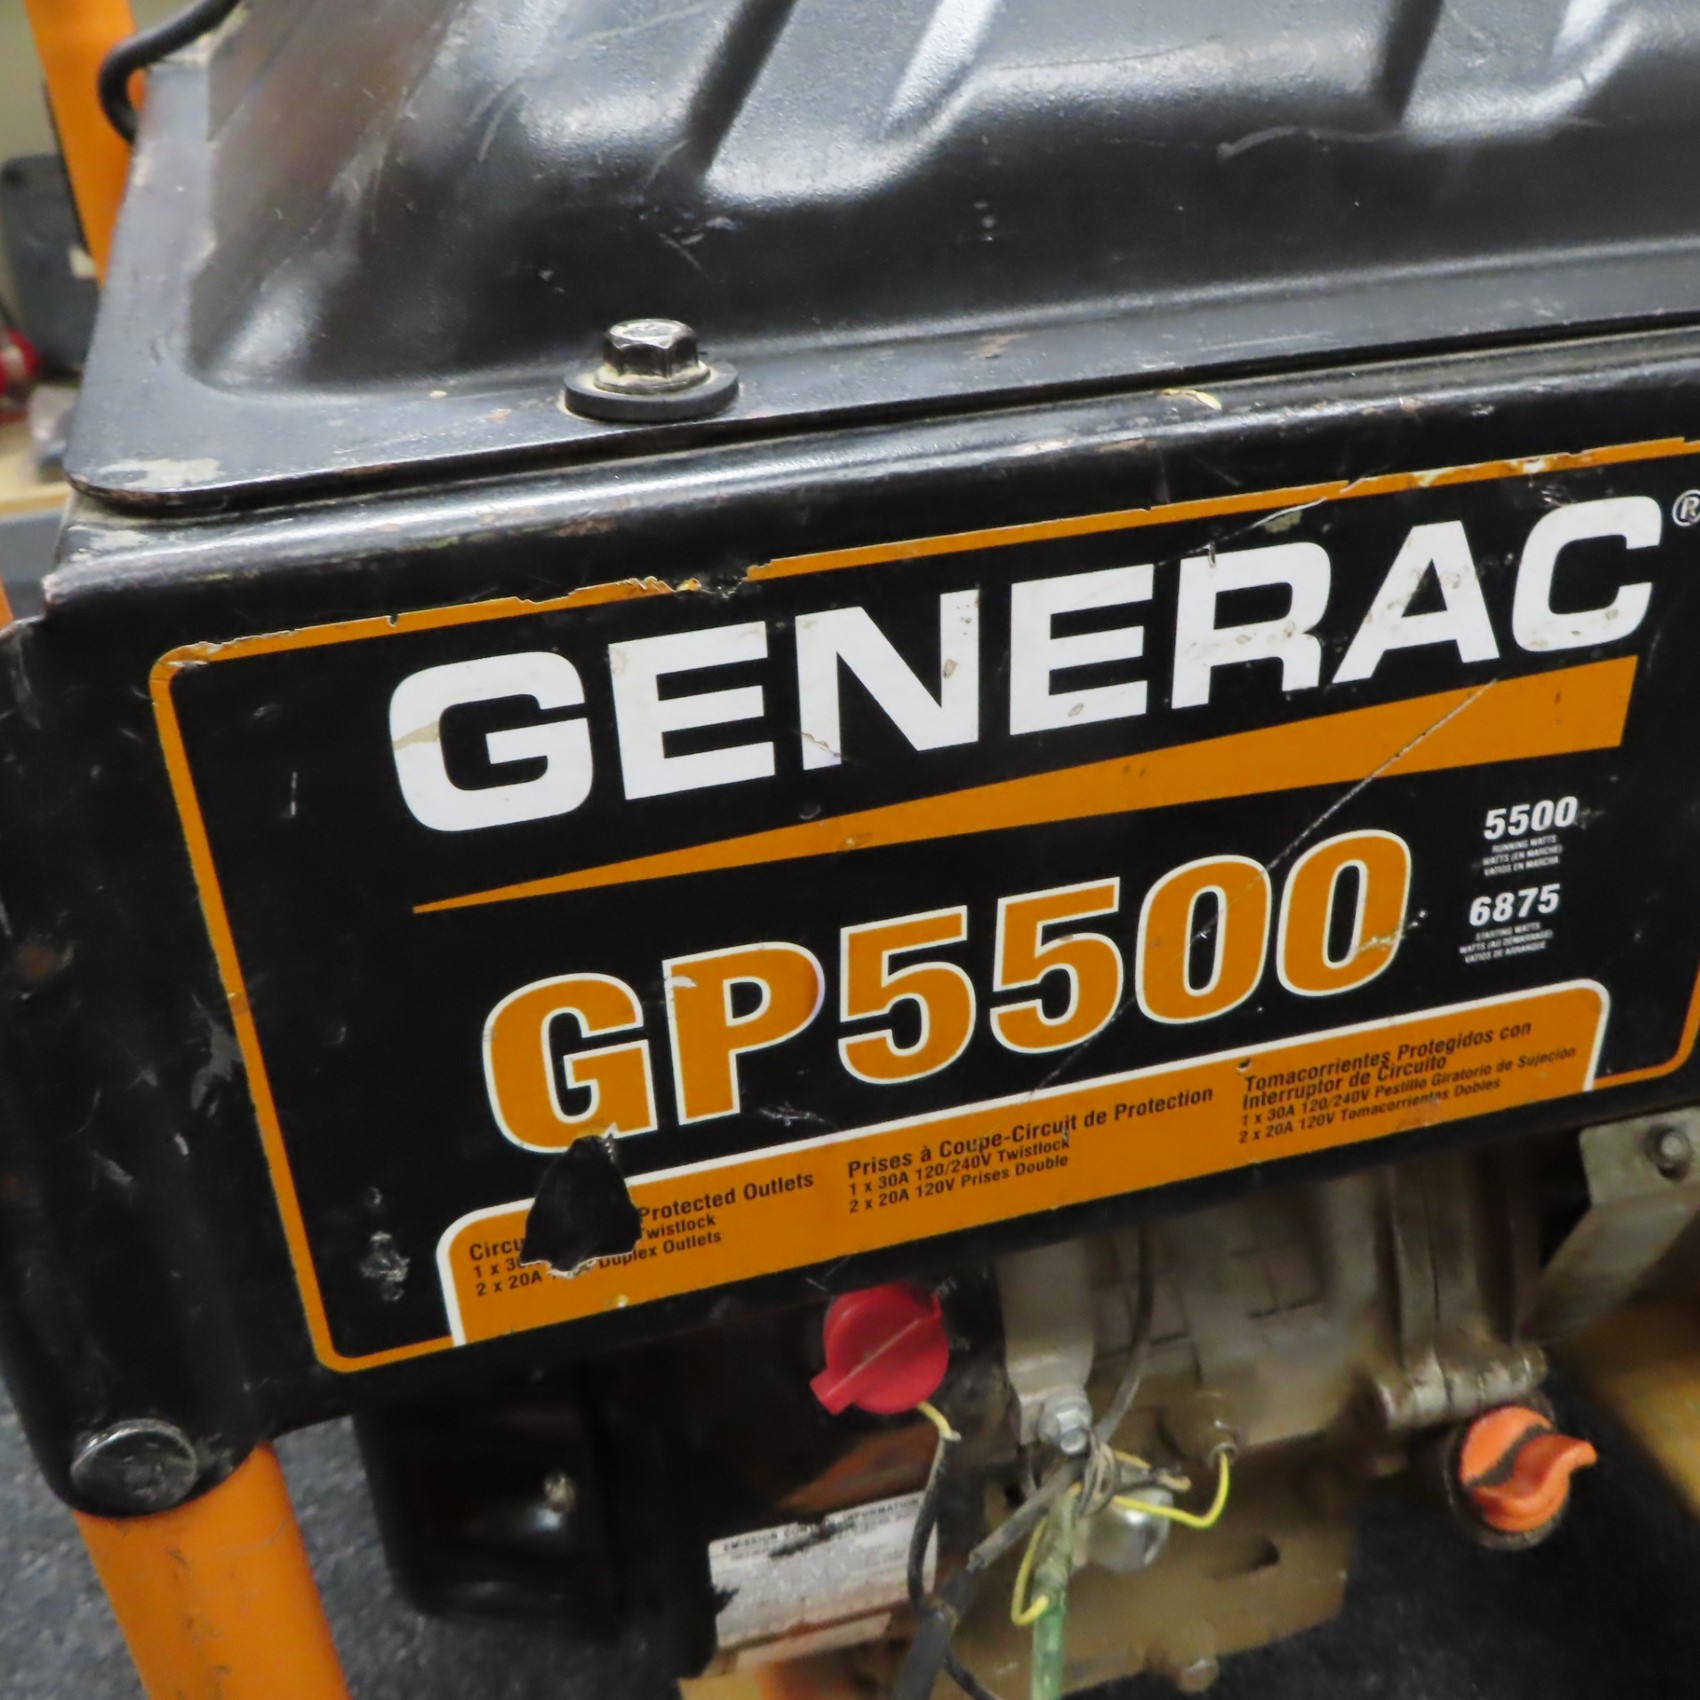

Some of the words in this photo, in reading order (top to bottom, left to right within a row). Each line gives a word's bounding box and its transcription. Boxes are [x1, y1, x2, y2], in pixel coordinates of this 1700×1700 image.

[389, 496, 1661, 832] GENERAC
[1483, 796, 1578, 840] 5500
[1469, 883, 1561, 926] 6875
[483, 829, 1412, 1153] GP5500
[1243, 1076, 1343, 1111] Interruptor
[1349, 1068, 1372, 1087] de
[1377, 1055, 1448, 1083] Circuito
[1245, 1050, 1391, 1093] Tomacorrientes
[1397, 1030, 1494, 1062] Protegidos
[1499, 1021, 1532, 1042] con
[1238, 1130, 1249, 1144] 2
[1252, 1129, 1261, 1142] x
[1265, 1120, 1294, 1138] 20A
[1299, 1110, 1335, 1131] 120V
[1454, 1076, 1502, 1098] Dobles
[1241, 1114, 1250, 1128] 1
[1253, 1113, 1263, 1126] x
[1268, 1104, 1296, 1122] 30A
[1301, 1089, 1370, 1116] 120/240V
[1497, 1058, 1514, 1074] de
[848, 1153, 913, 1179] Prises
[920, 1145, 932, 1163] à
[939, 1114, 1077, 1158] Coupe-Circuit
[1084, 1108, 1107, 1128] de
[1114, 1086, 1214, 1122] Protection
[849, 1183, 857, 1197] 1
[864, 1181, 873, 1194] x
[878, 1170, 910, 1191] 30A
[915, 1153, 991, 1182] 120/240V
[998, 1137, 1071, 1164] Twistlock
[849, 1199, 859, 1214] 2
[864, 1198, 874, 1211] x
[879, 1186, 910, 1208] 20A
[916, 1177, 956, 1199] 120V
[961, 1167, 1010, 1189] Prises
[1015, 1154, 1069, 1178] Double
[470, 1236, 524, 1262] Circu
[639, 1187, 737, 1221] Protected
[743, 1170, 814, 1200] Outlets
[474, 1265, 483, 1279] 1
[491, 1263, 500, 1276] x
[475, 1282, 487, 1297] 2
[494, 1281, 503, 1293] x
[509, 1269, 543, 1290] 20A
[663, 1231, 722, 1255] Outlets
